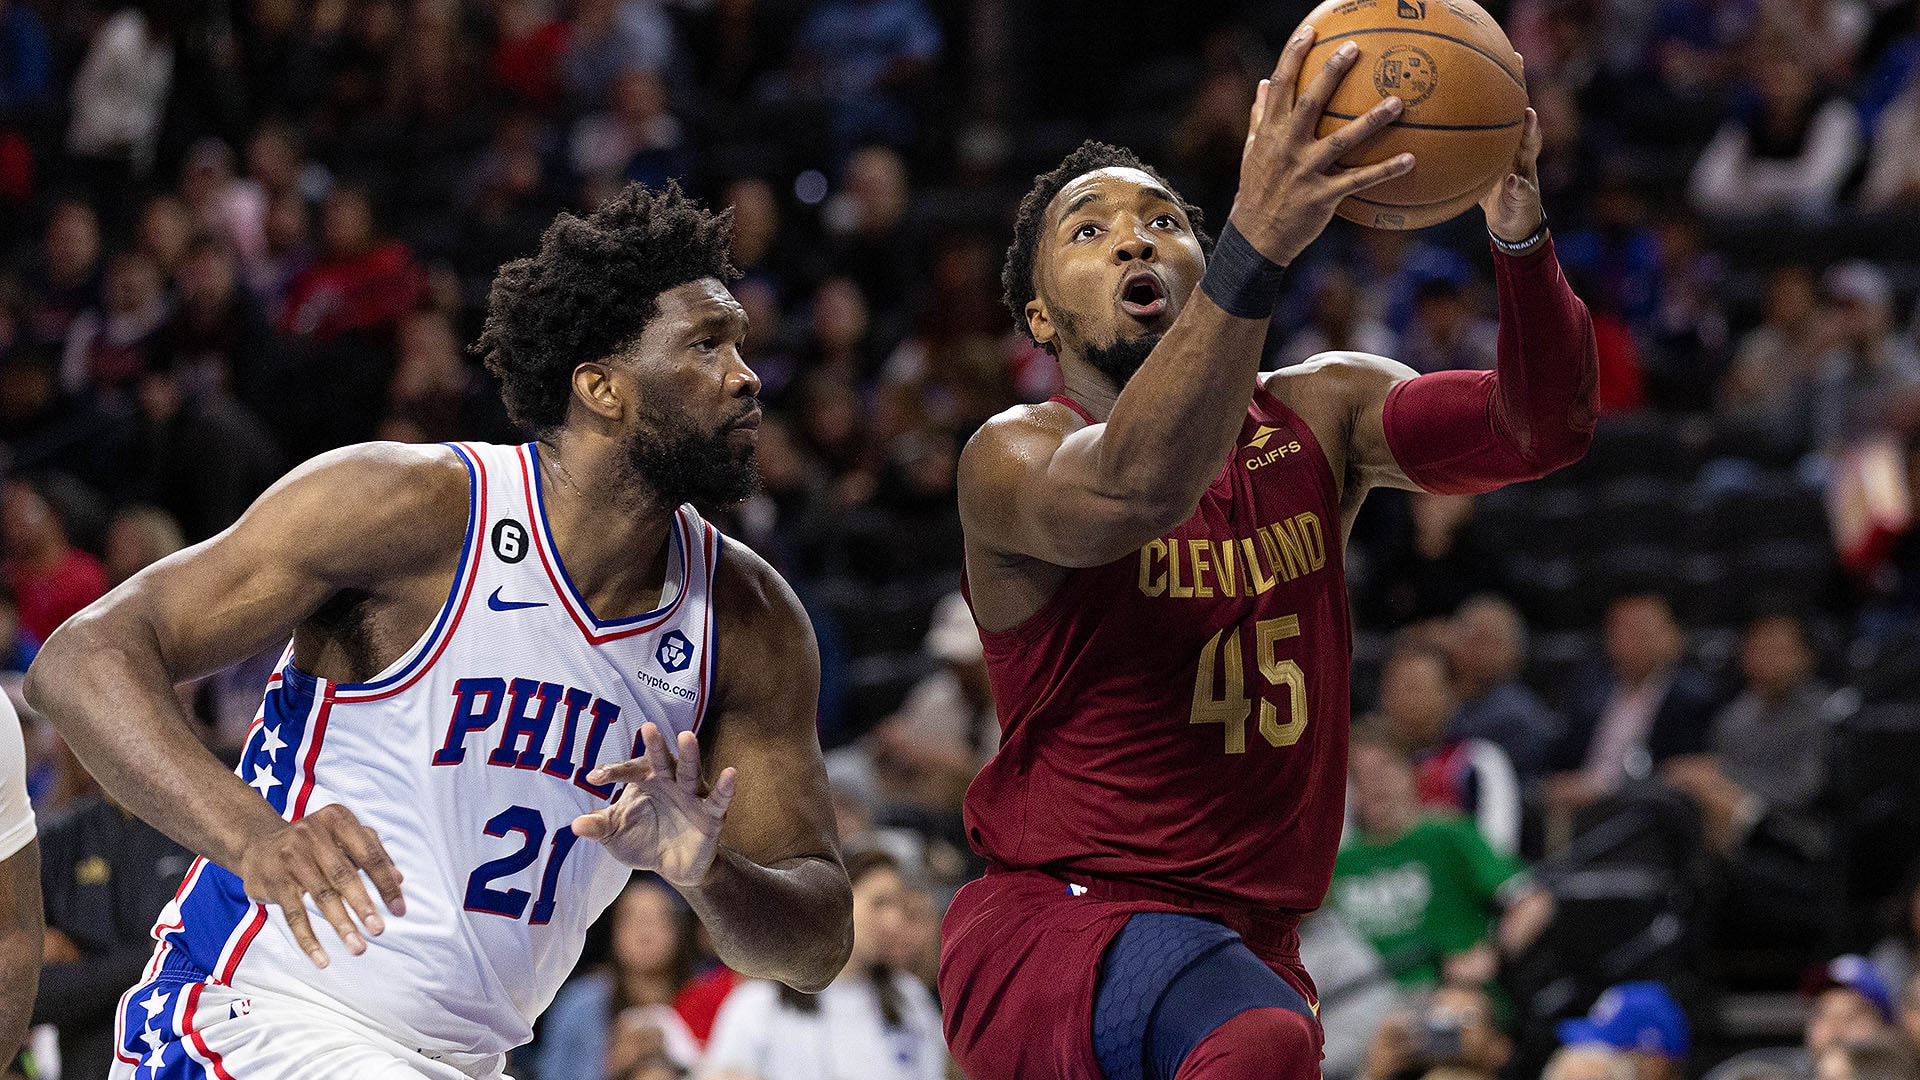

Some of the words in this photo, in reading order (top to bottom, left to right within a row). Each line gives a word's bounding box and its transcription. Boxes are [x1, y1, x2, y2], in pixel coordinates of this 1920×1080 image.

[1508, 234, 1540, 250] WEALTH
[1246, 440, 1302, 471] CLIFFS
[498, 524, 521, 559] 6
[637, 670, 697, 701] crypto.com
[1189, 613, 1308, 754] 45
[432, 677, 646, 805] PHIL
[463, 805, 580, 925] 21
